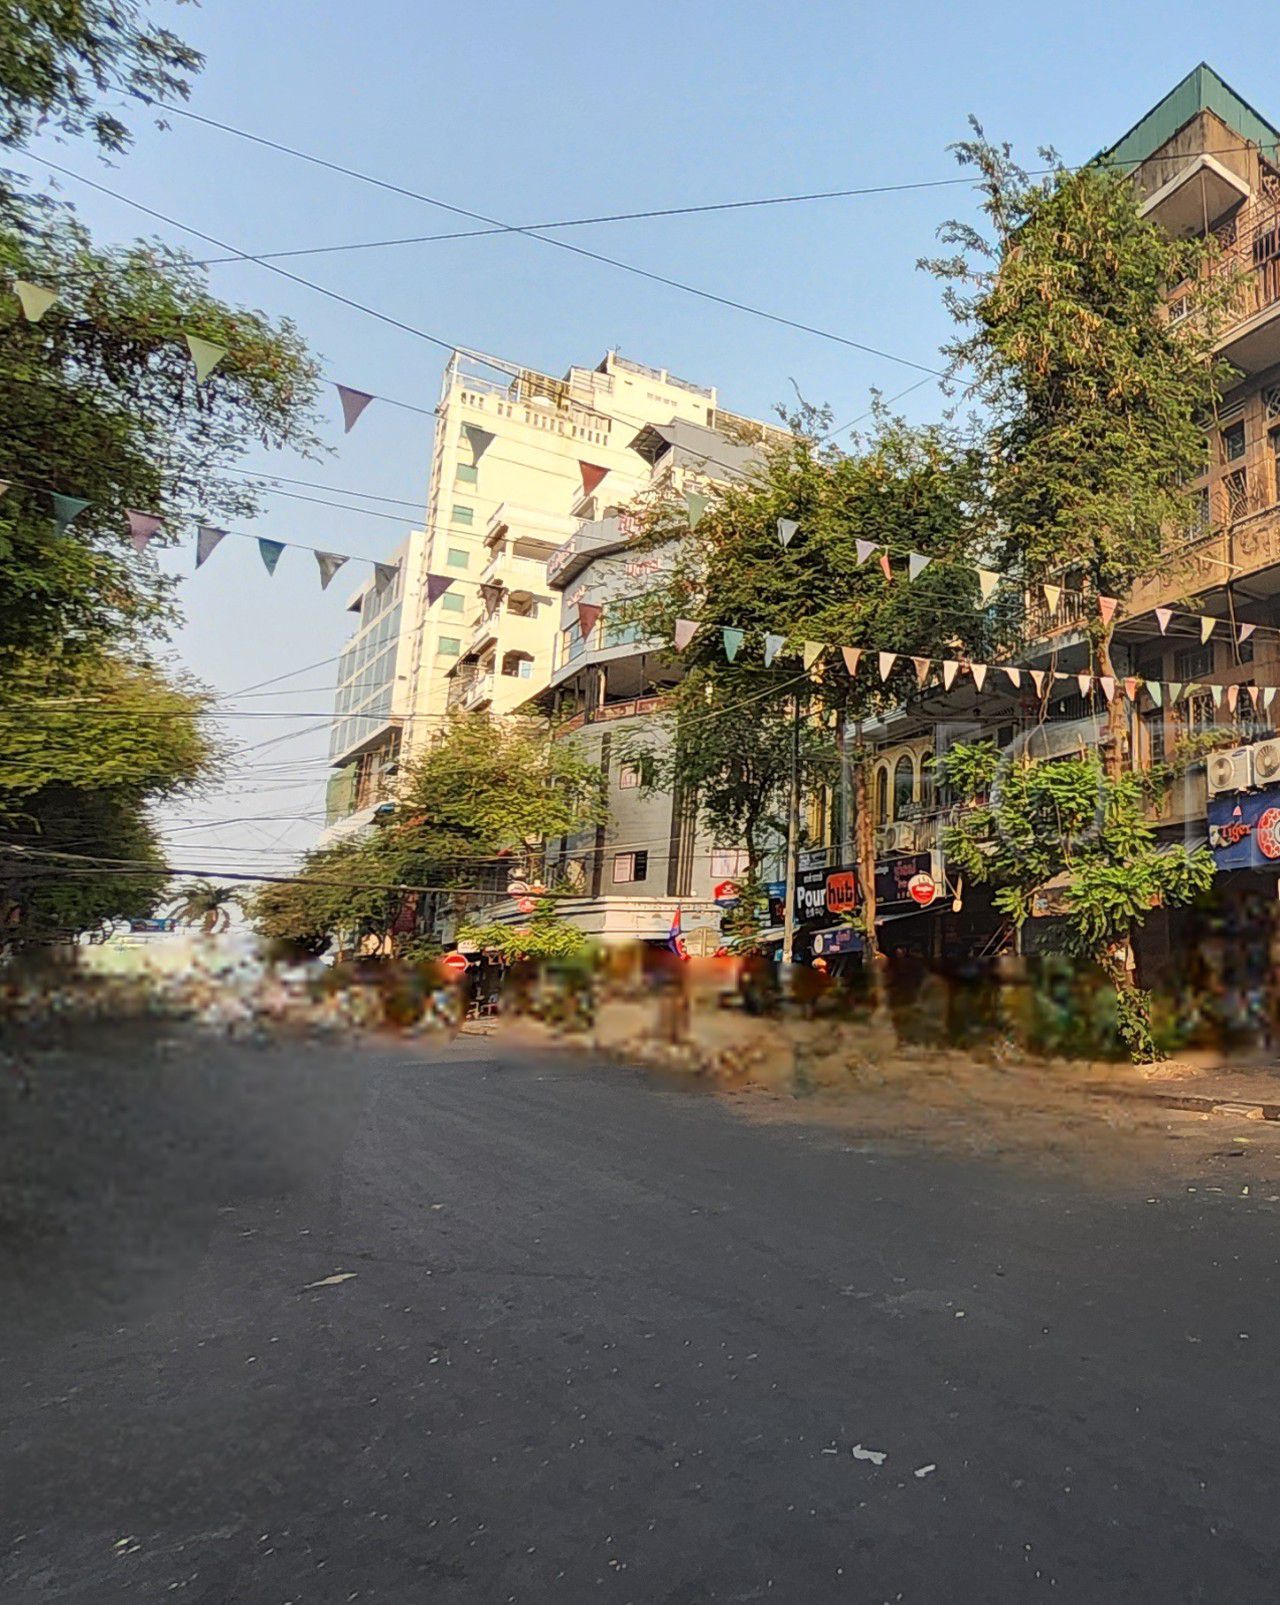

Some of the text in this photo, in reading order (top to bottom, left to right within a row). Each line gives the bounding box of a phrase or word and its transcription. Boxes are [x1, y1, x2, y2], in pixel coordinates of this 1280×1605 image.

[1219, 820, 1252, 843] Tiger
[797, 879, 854, 909] Pour hub
